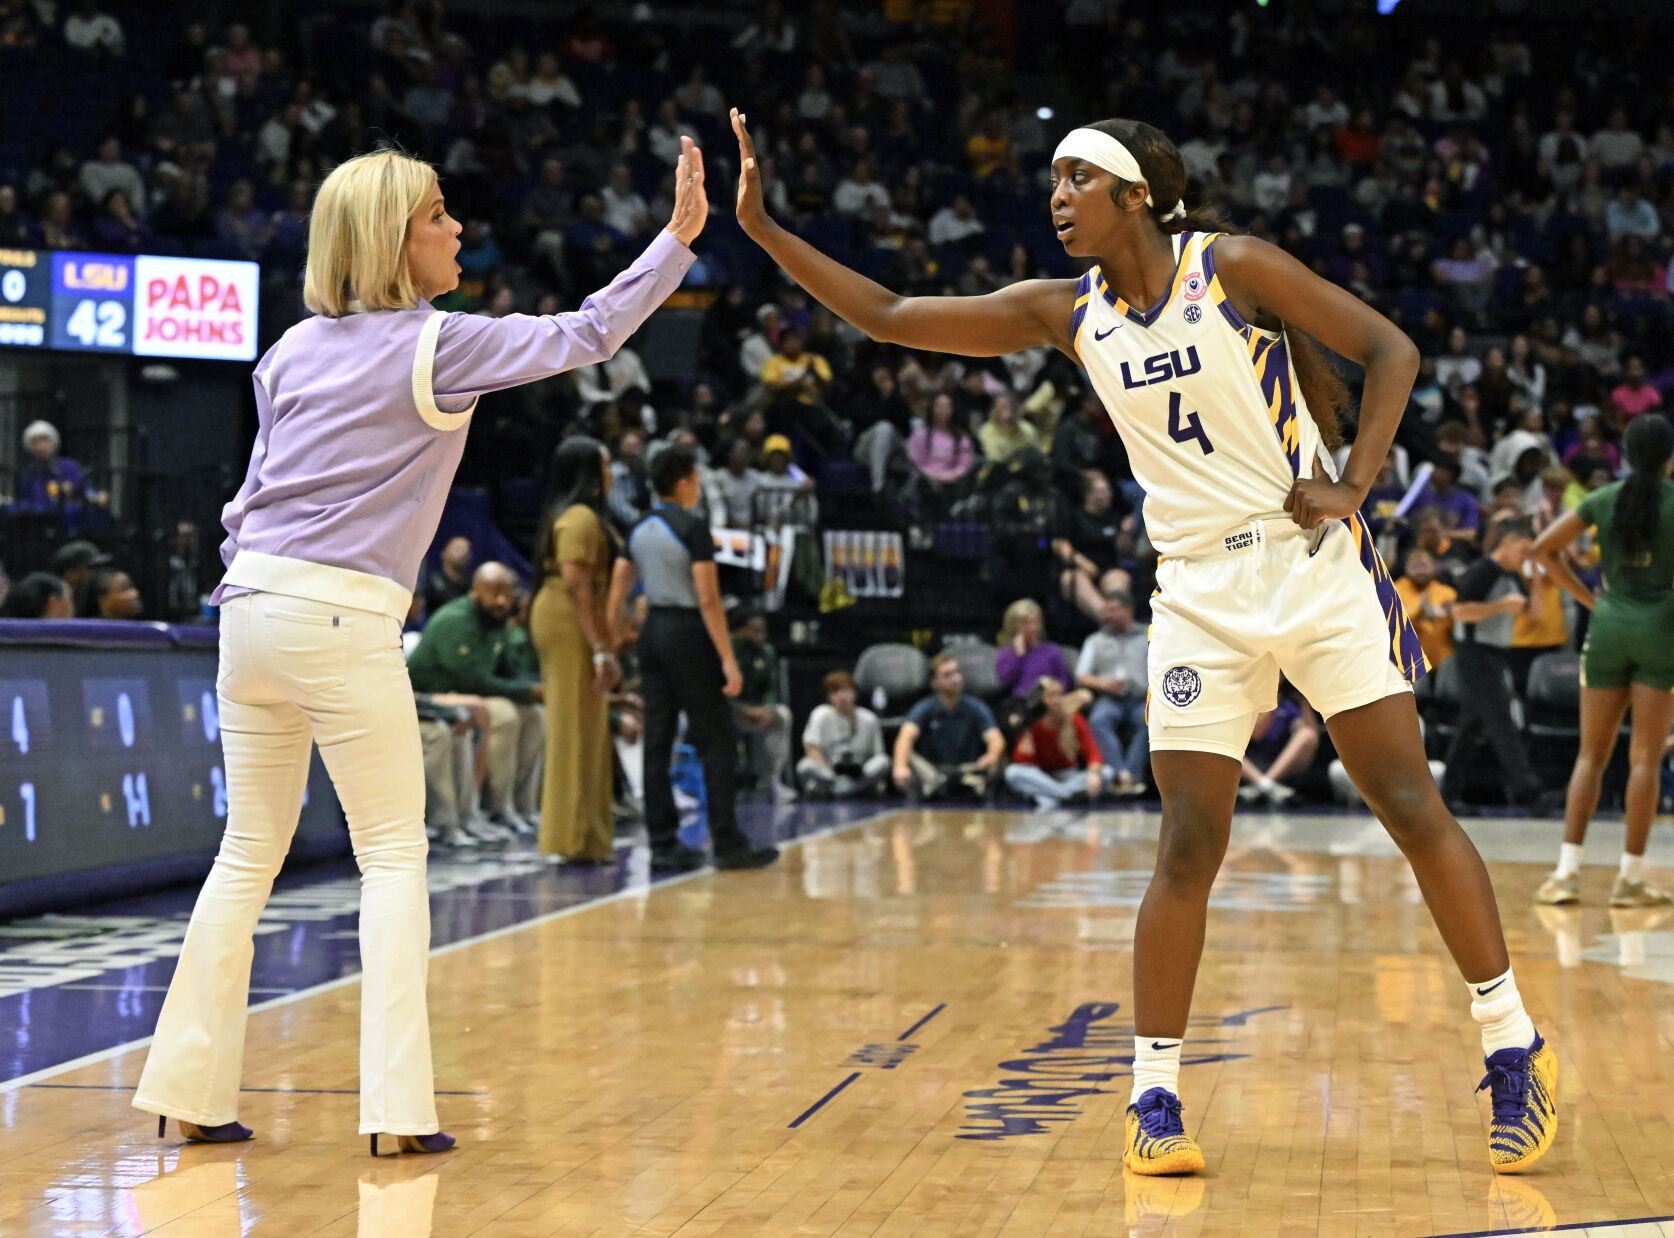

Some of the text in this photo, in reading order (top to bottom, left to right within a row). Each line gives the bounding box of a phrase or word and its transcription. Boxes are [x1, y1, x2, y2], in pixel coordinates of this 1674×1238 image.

[2, 270, 26, 302] 0
[64, 261, 128, 291] LSU
[148, 274, 242, 313] PAPA
[67, 299, 127, 347] 42
[1185, 305, 1201, 322] SEC
[145, 317, 243, 345] JOHNS
[1120, 345, 1201, 389] LSU
[1168, 392, 1214, 455] 4
[1225, 529, 1260, 545] GEAU
